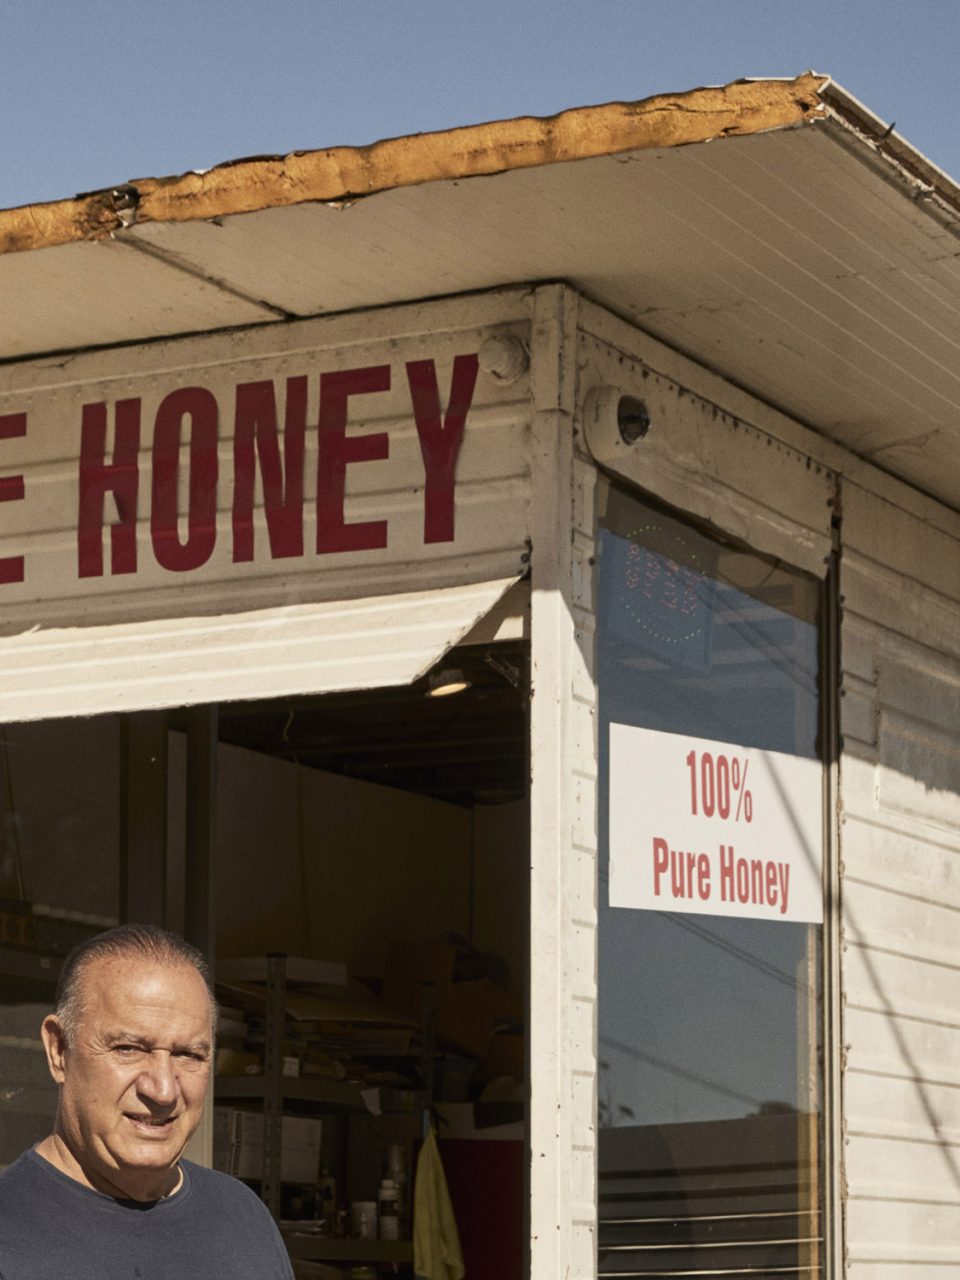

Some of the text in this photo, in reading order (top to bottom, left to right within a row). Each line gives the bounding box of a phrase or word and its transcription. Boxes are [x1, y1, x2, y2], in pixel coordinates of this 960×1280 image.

[76, 354, 479, 579] HONEY
[686, 750, 753, 823] 100%
[652, 837, 790, 915] Pure Honey
